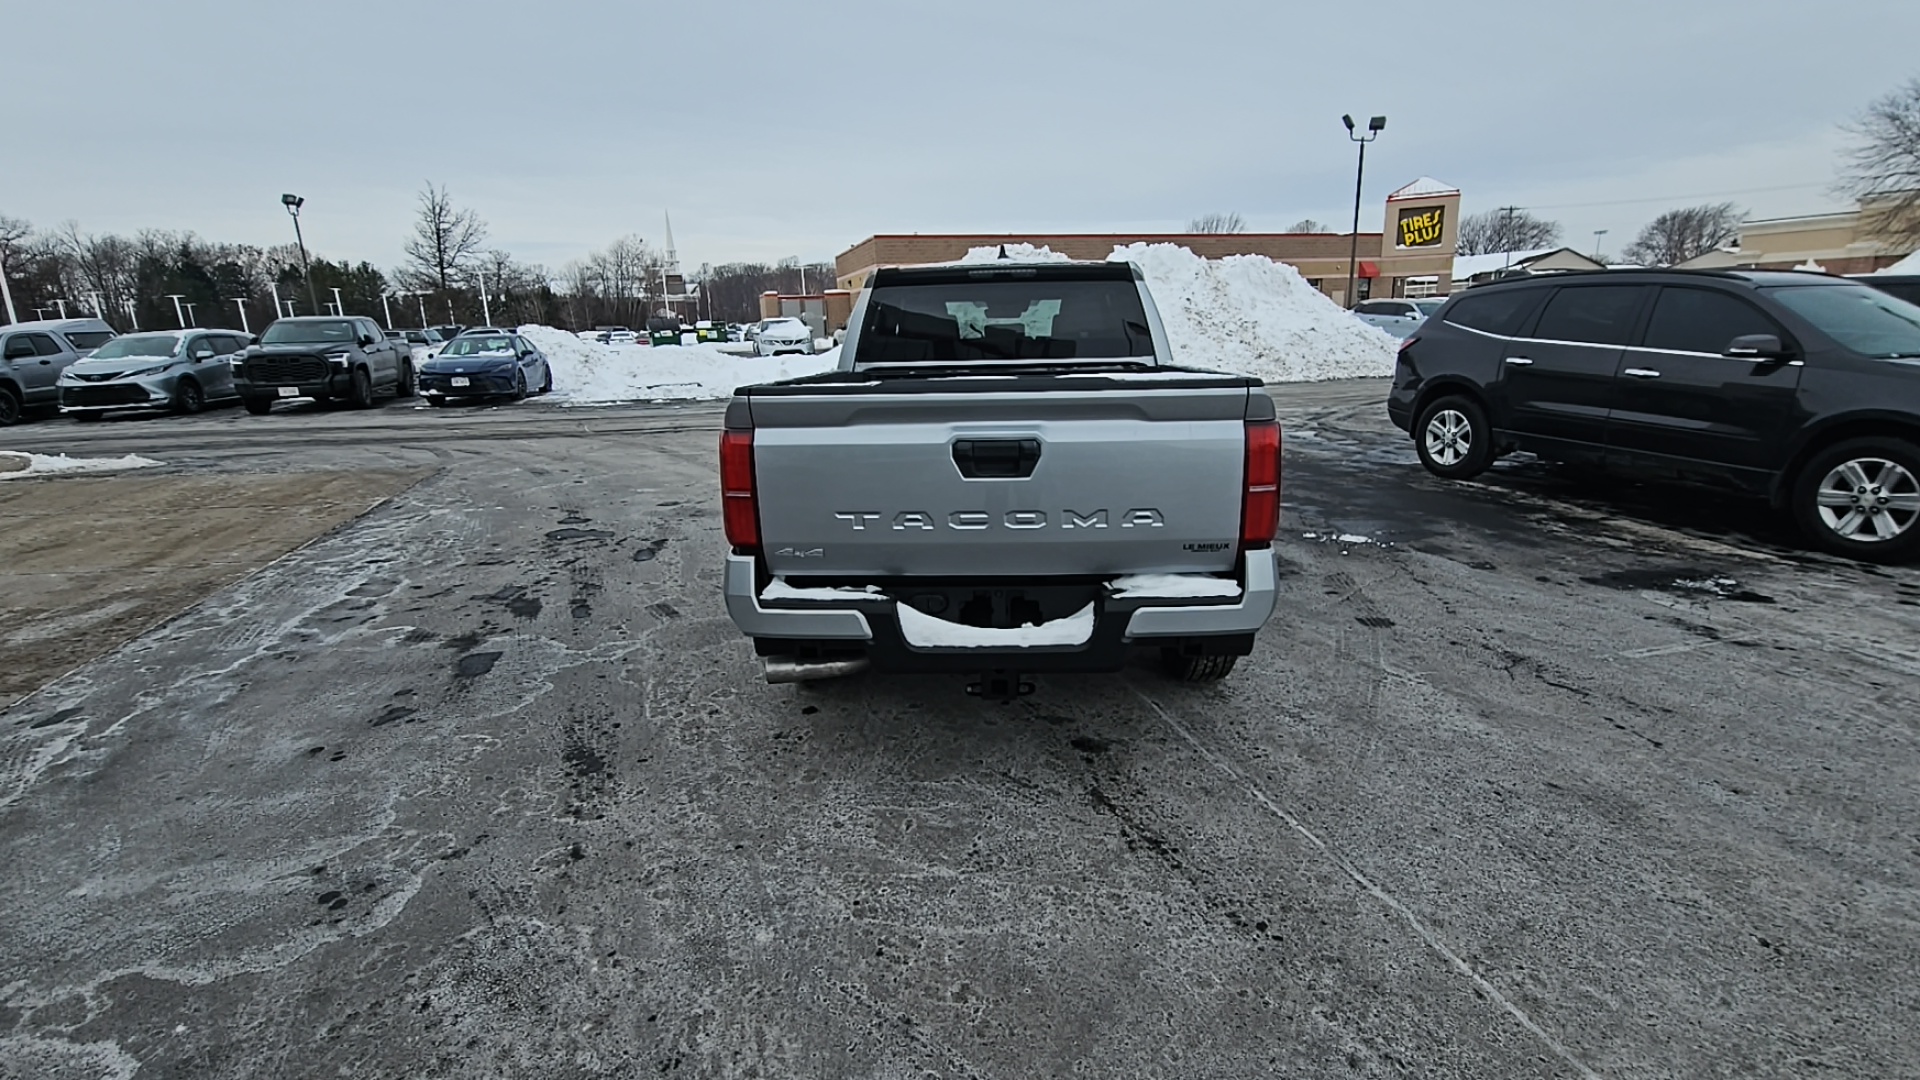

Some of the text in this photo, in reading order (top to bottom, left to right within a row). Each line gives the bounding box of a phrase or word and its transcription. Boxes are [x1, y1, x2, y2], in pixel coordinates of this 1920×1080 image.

[1400, 210, 1441, 233] TIRES
[1404, 224, 1441, 246] PLUS
[834, 508, 1164, 530] TACOMA
[1197, 542, 1230, 550] MIEUX
